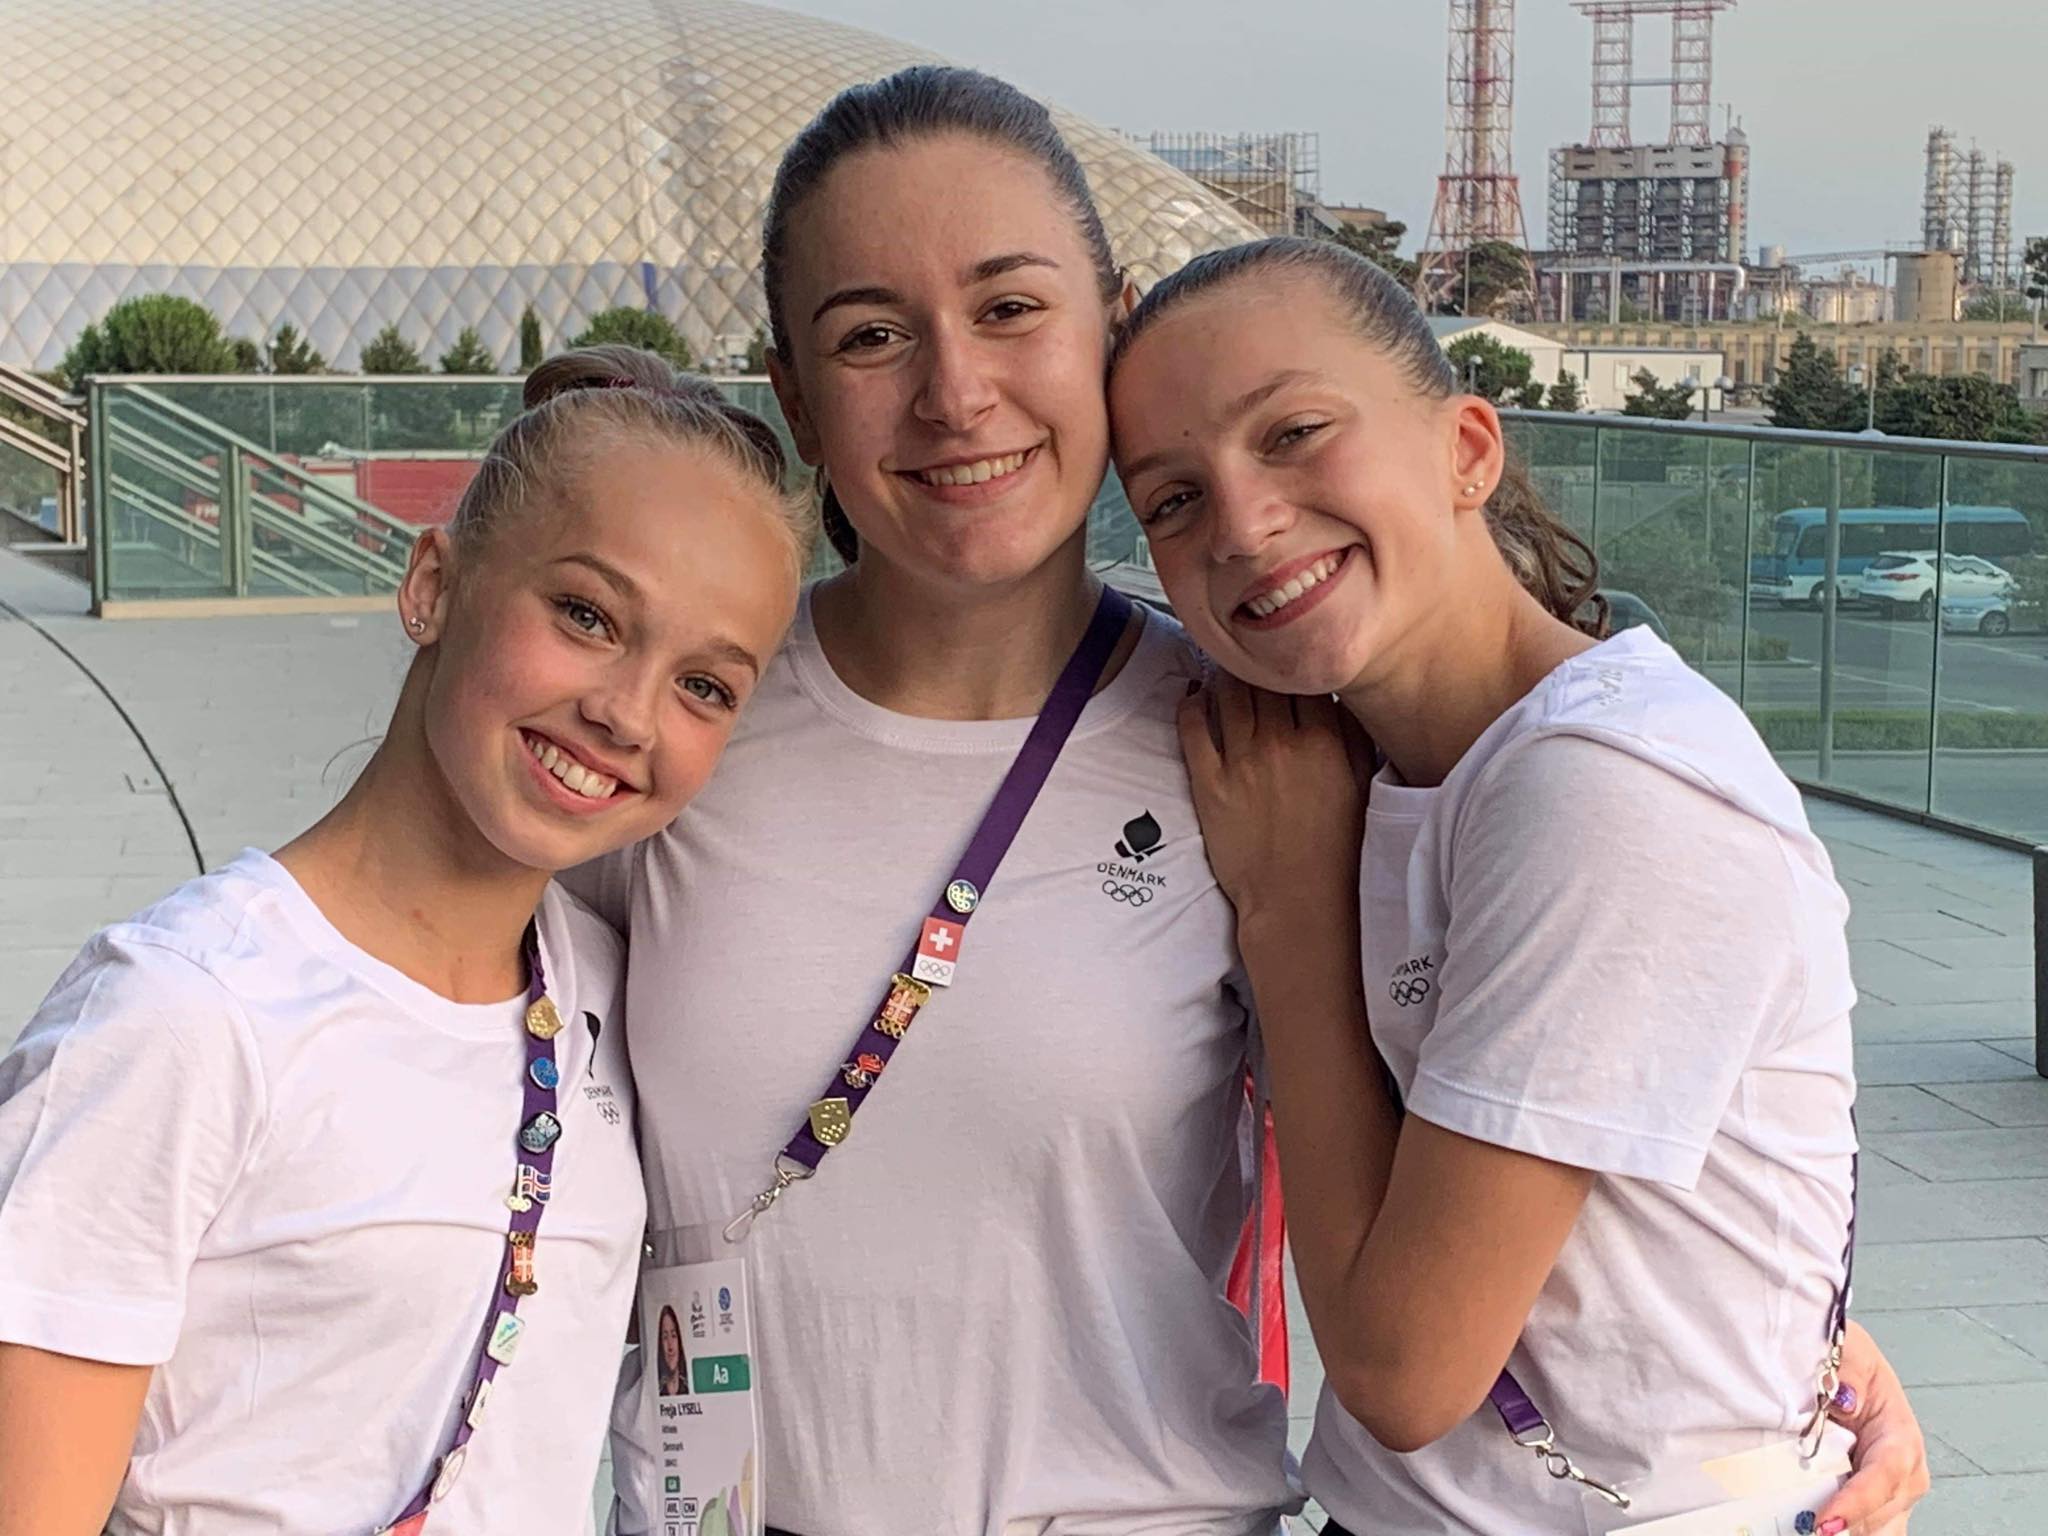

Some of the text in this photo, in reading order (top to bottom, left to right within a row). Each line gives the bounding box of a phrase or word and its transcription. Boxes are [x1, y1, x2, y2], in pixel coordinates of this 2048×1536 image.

[1096, 862, 1167, 888] DENMARK
[712, 1363, 729, 1385] Aa
[677, 1402, 703, 1416] LYSELL
